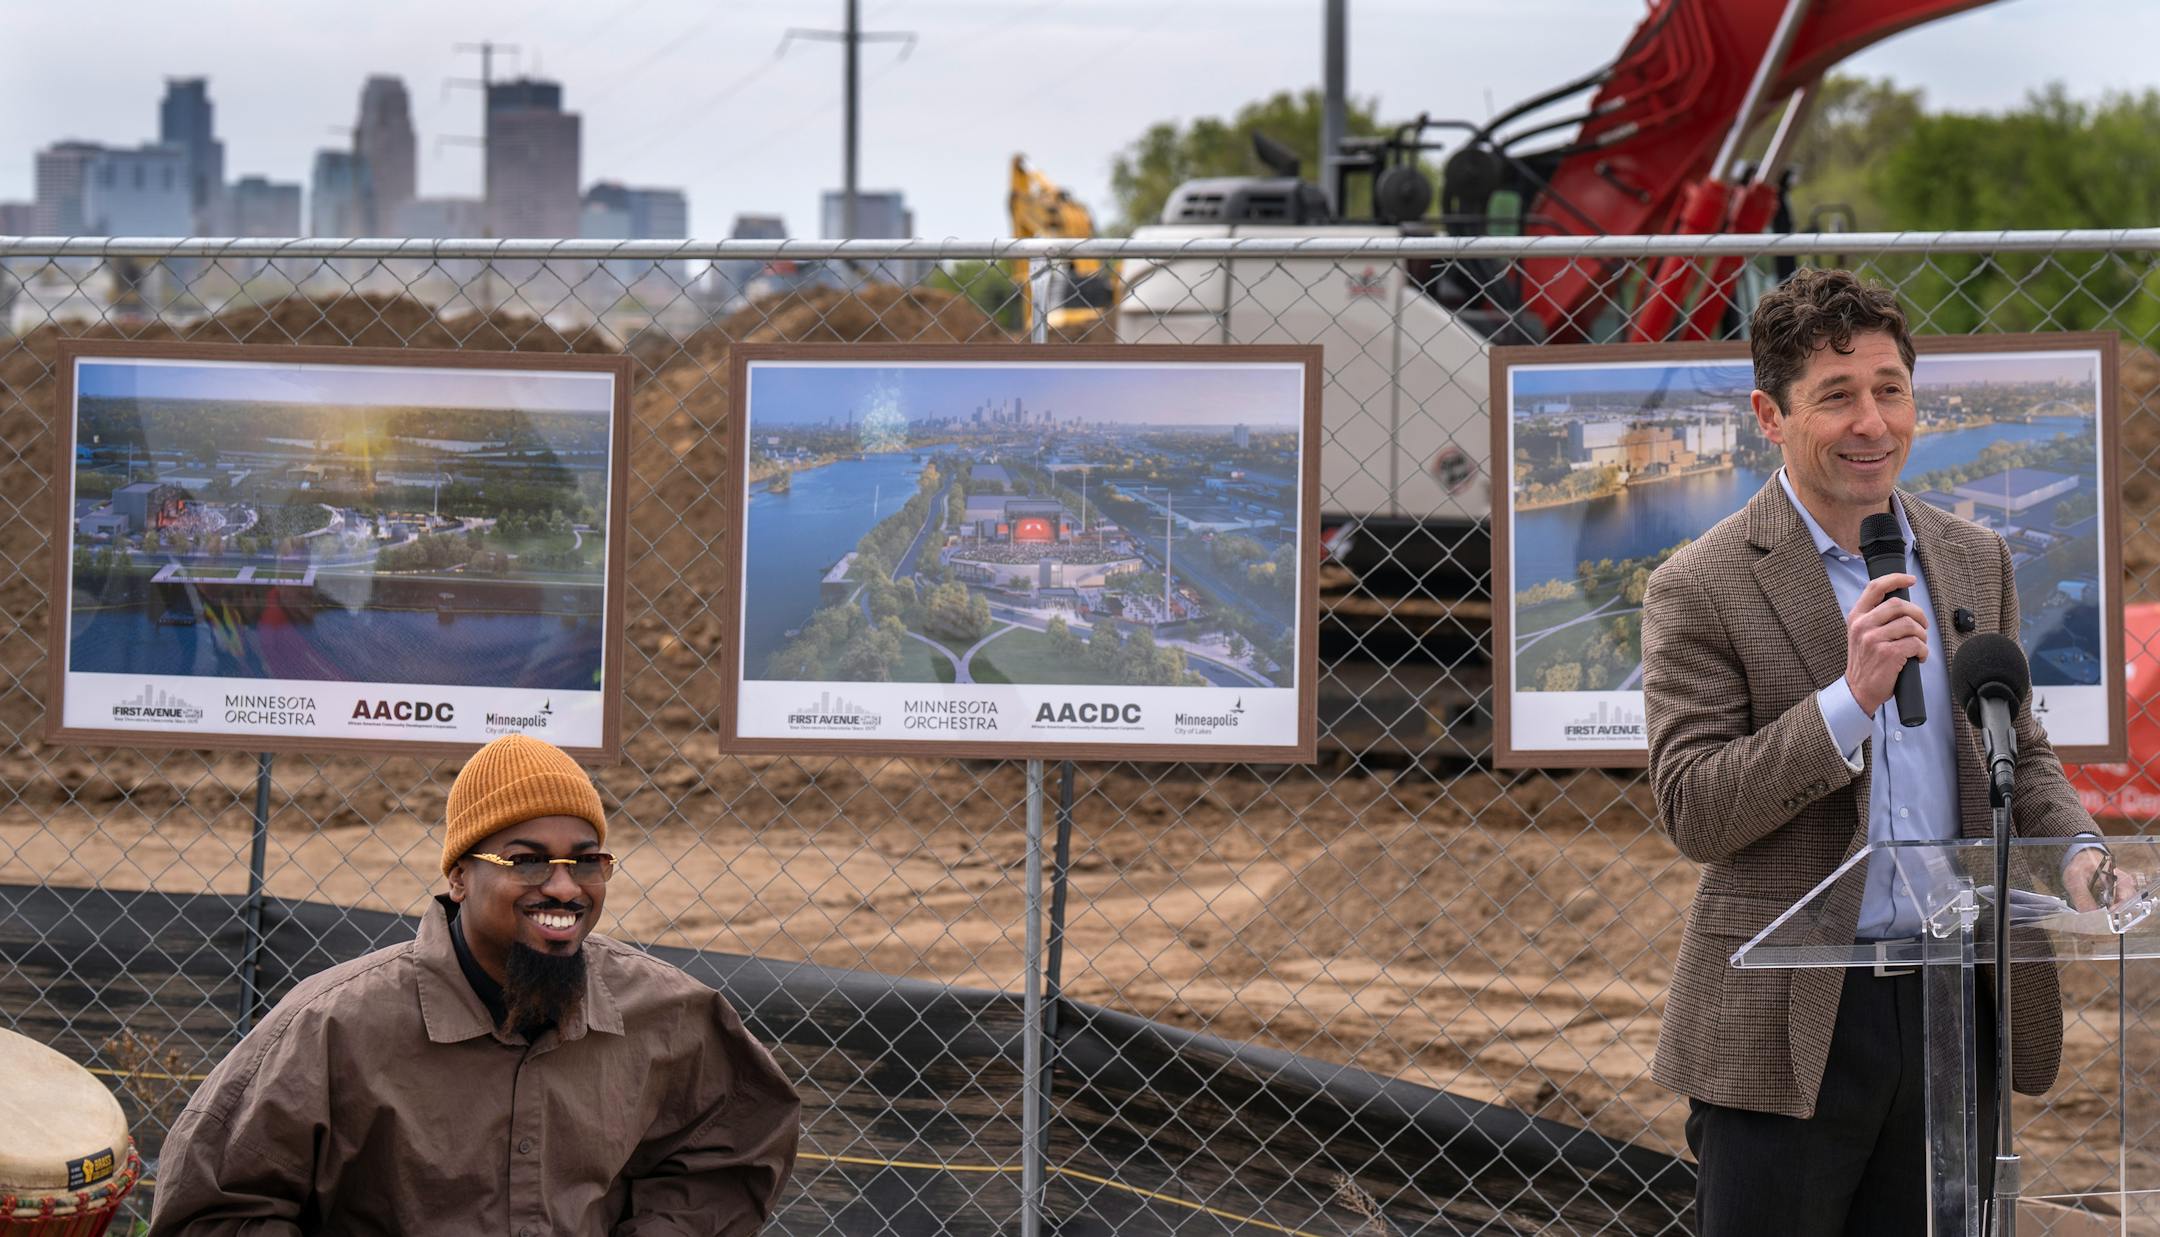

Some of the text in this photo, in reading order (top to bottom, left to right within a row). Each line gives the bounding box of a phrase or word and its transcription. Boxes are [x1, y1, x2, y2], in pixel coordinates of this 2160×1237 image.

[225, 695, 316, 710] MINNESOTA
[904, 700, 998, 714] MINNESOTA
[114, 706, 142, 717] FIRST
[143, 707, 182, 718] AVENUE
[225, 710, 316, 726] ORCHESTRA
[352, 699, 454, 722] AACDC
[1035, 702, 1142, 724] AACDC
[486, 712, 547, 728] Minneapolis
[790, 714, 818, 724] FIRST
[819, 715, 860, 725] AVENUE
[904, 715, 998, 730] ORCHESTRA
[1175, 713, 1239, 728] Minneapolis
[1174, 727, 1186, 735] City
[1195, 727, 1212, 735] Lakes
[1567, 725, 1641, 735] FIRST AVENUE
